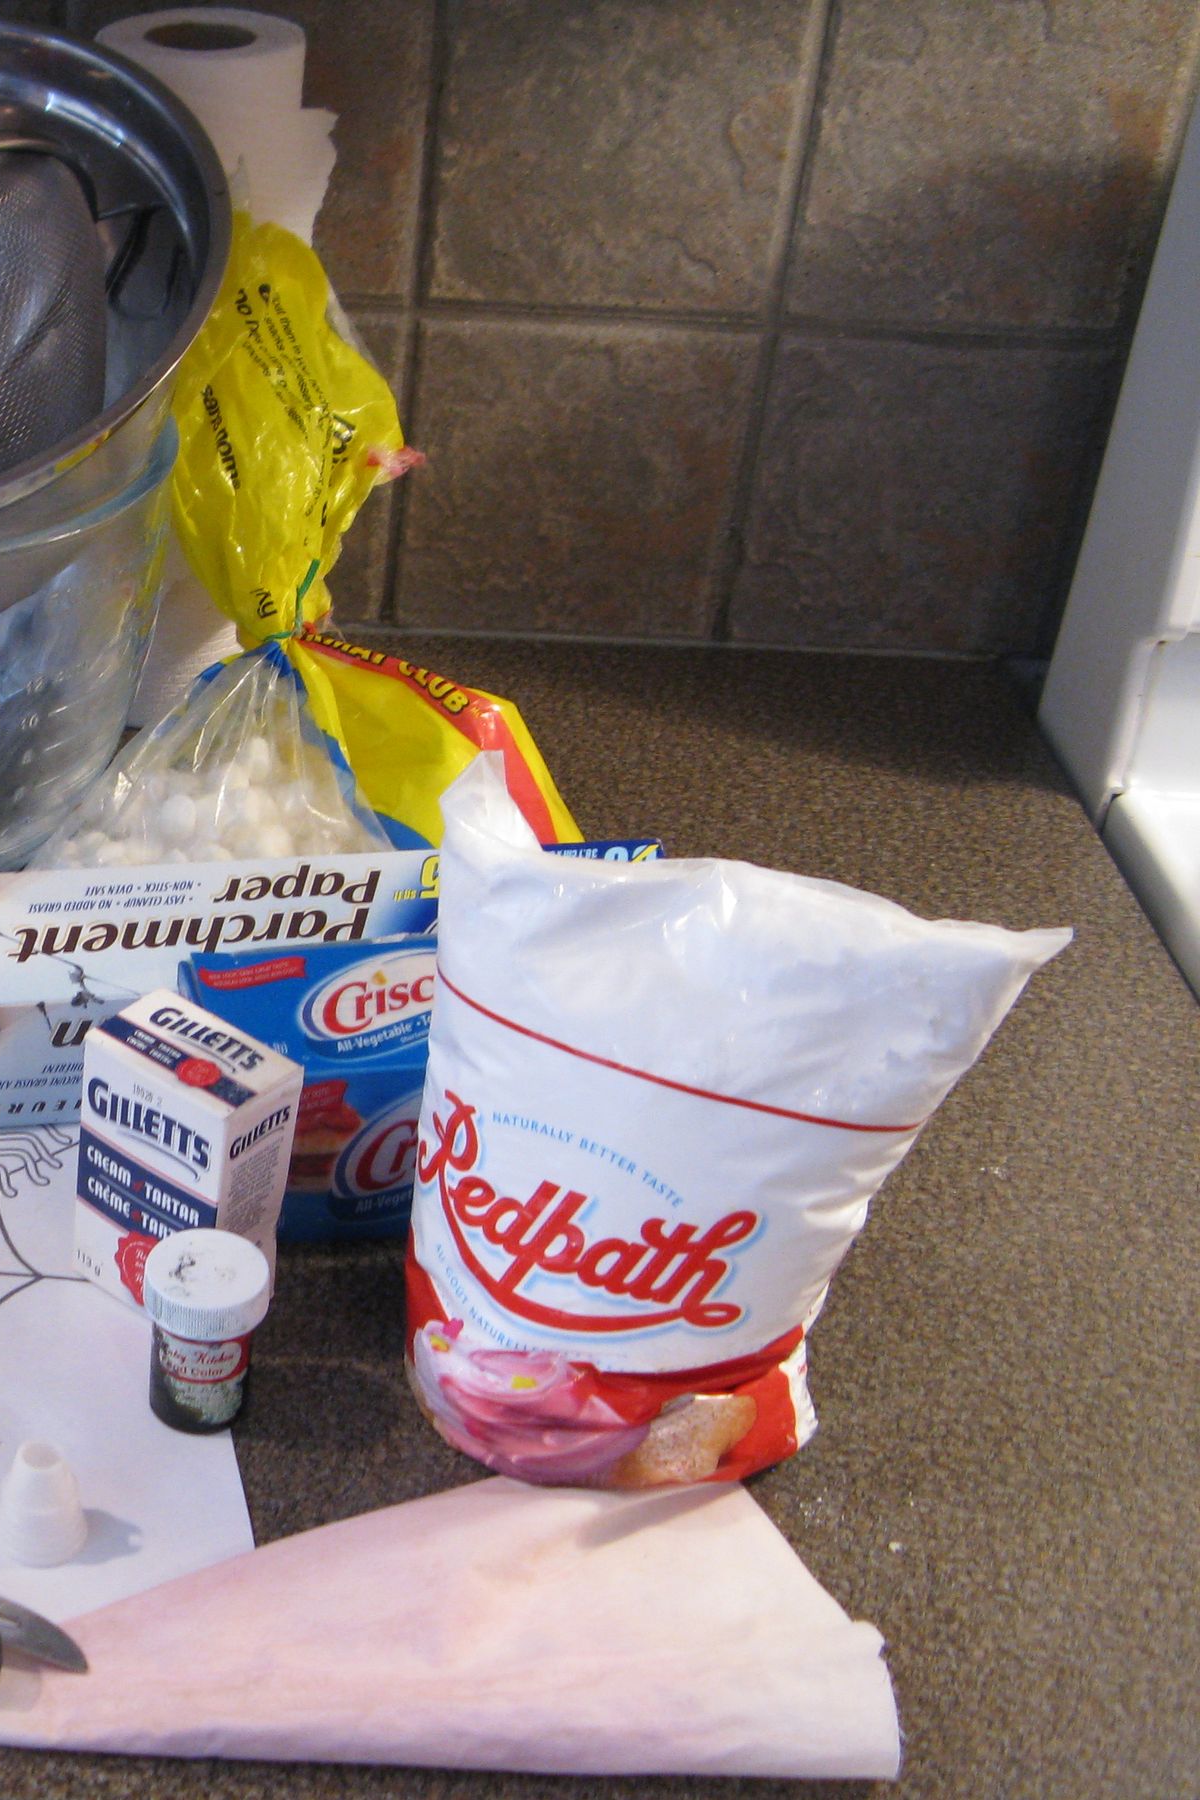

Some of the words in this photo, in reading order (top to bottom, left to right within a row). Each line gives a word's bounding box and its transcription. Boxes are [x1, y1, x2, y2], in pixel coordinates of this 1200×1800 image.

[398, 660, 470, 715] CLUB
[63, 901, 96, 913] ADDED
[107, 884, 134, 895] OVEN
[213, 863, 382, 904] Paper
[7, 906, 370, 963] Parchment
[322, 973, 435, 1035] Crisc
[86, 1144, 131, 1187] CREAM
[144, 1182, 200, 1227] TARTAR
[491, 1109, 574, 1145] NATURALLY
[579, 1137, 637, 1176] BETTER
[642, 1169, 684, 1209] TASTE
[141, 1210, 176, 1241] TART
[417, 1088, 760, 1329] Redpath
